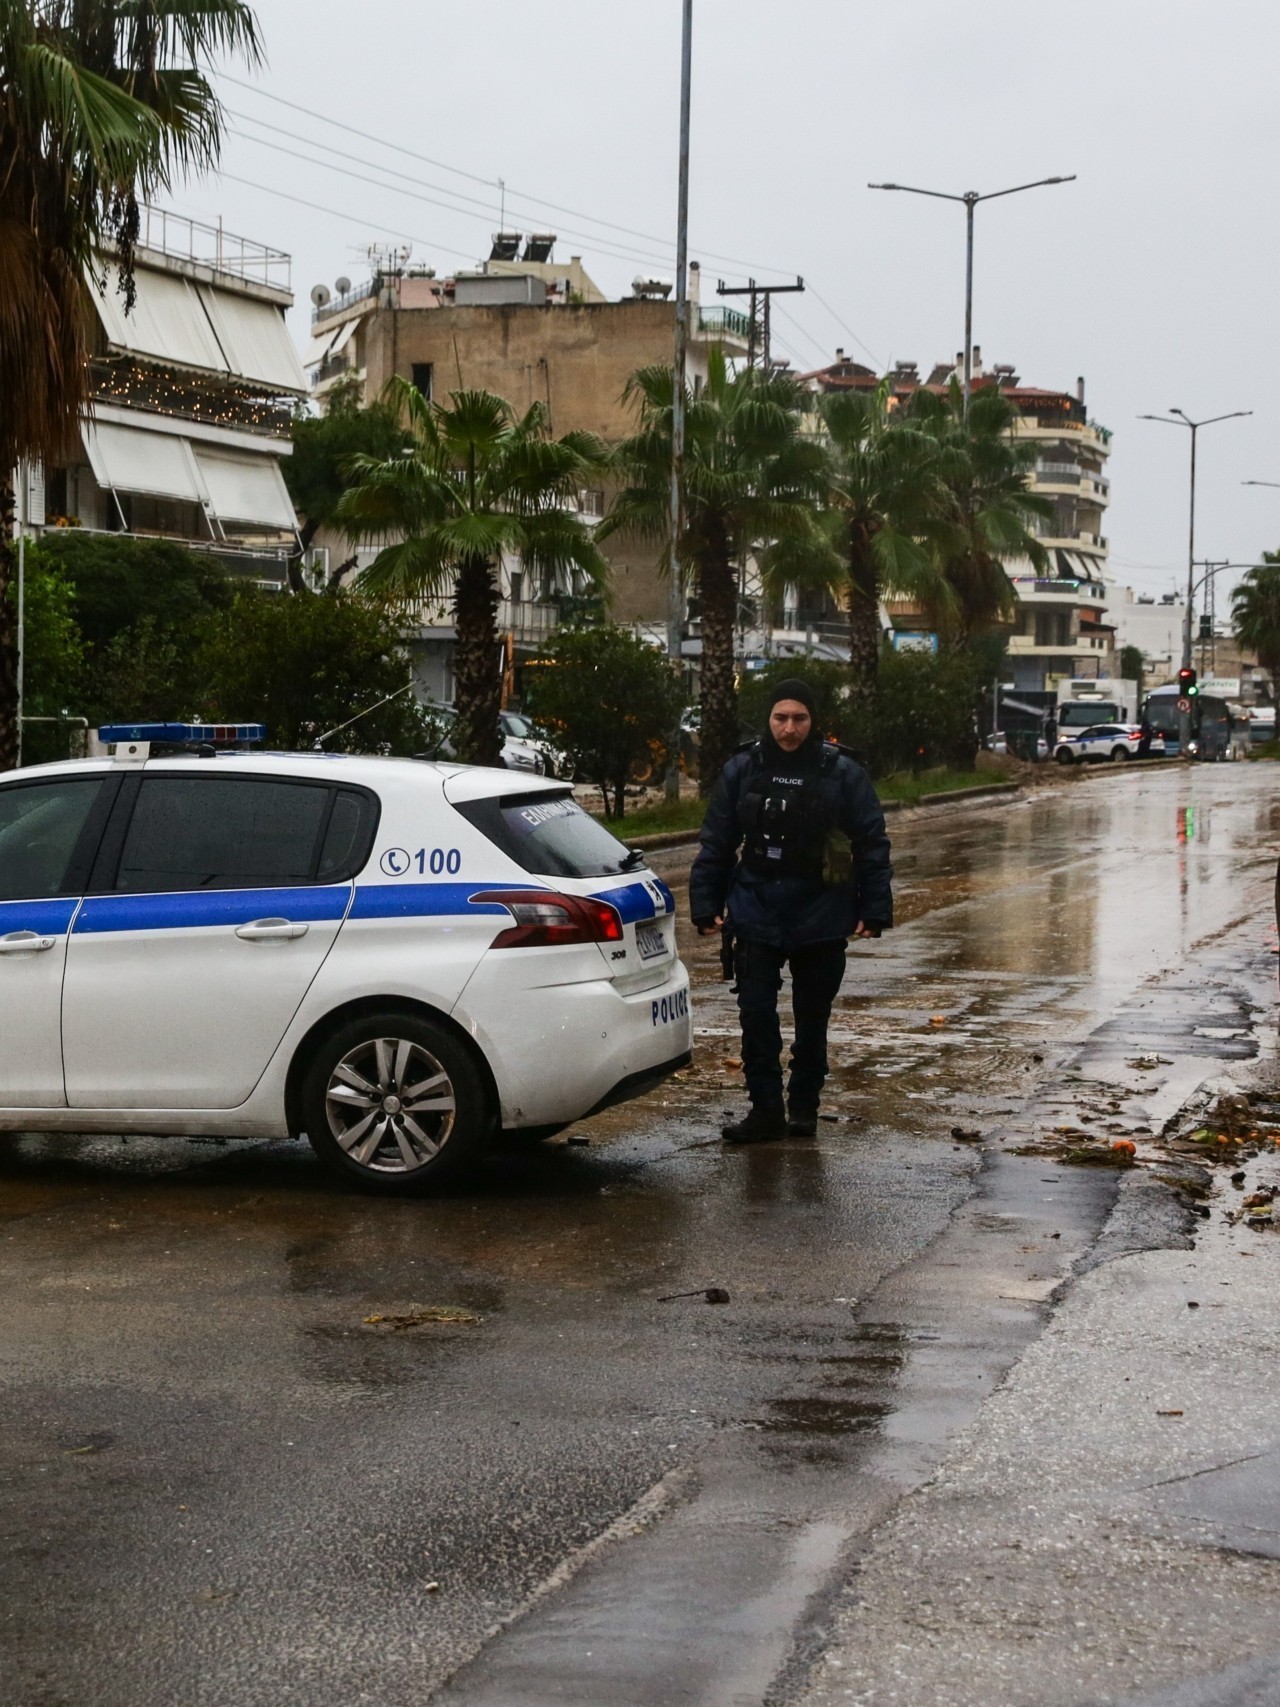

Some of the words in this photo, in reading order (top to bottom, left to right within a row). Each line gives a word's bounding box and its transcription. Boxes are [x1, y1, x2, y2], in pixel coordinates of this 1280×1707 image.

[772, 776, 804, 786] POLICE
[414, 848, 461, 875] 100
[611, 950, 626, 960] 308
[652, 987, 688, 1027] POLICE
